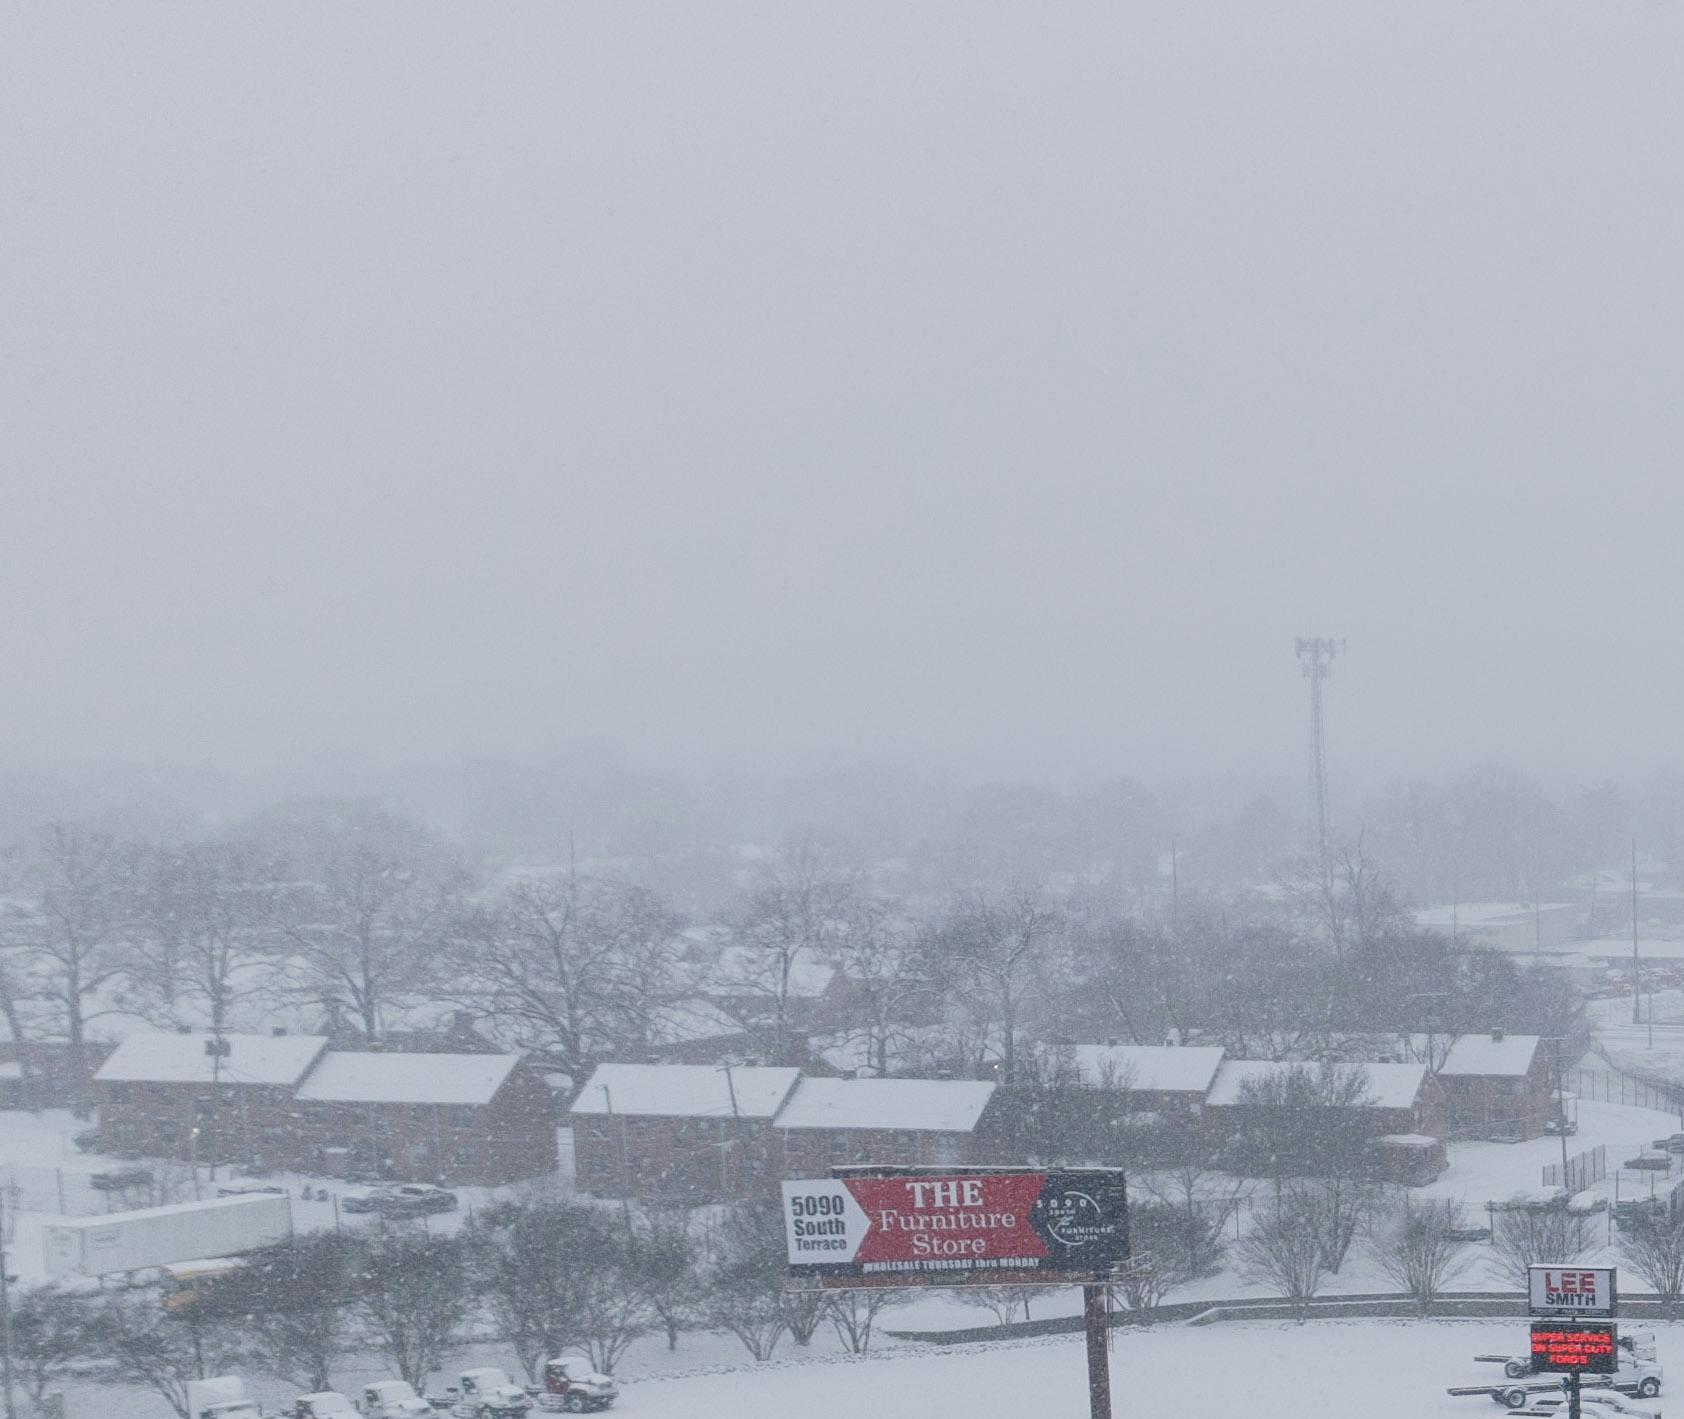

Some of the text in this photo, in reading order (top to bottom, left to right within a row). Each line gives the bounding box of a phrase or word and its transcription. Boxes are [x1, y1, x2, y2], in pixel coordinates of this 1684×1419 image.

[906, 1180, 983, 1208] THE
[791, 1195, 845, 1216] 5090
[794, 1217, 846, 1236] South
[880, 1206, 1016, 1233] Furniture
[795, 1238, 847, 1251] Terrace
[912, 1232, 987, 1256] Store
[863, 1260, 920, 1274] WHOLESALE
[923, 1259, 972, 1270] THURSDAY
[999, 1257, 1041, 1268] MONDAY
[1545, 1272, 1595, 1293] LEE
[1545, 1293, 1596, 1306] SMITH
